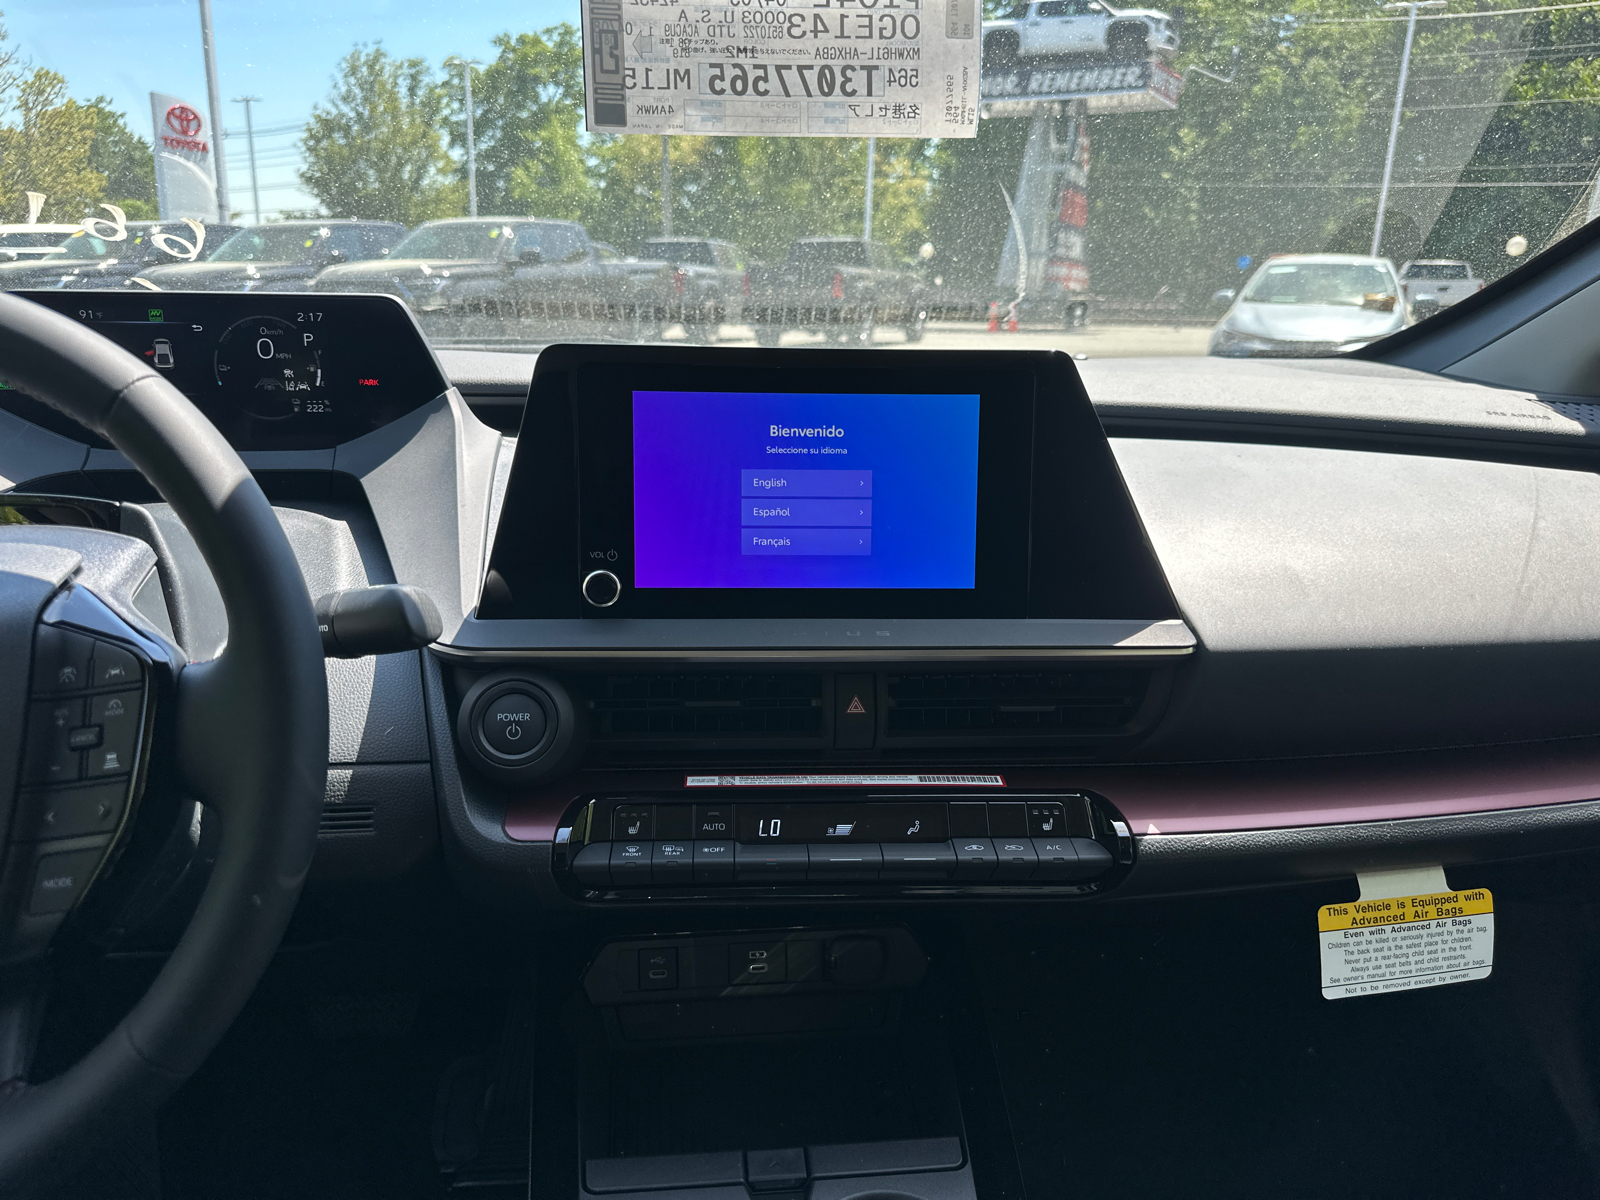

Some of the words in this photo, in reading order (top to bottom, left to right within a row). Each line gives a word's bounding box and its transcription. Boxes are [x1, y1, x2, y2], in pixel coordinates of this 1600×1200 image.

[162, 135, 209, 154] TOYOTA
[79, 309, 94, 319] 91
[297, 312, 323, 322] 2:17
[303, 333, 314, 347] P
[256, 338, 274, 359] 0
[359, 378, 380, 387] PARK
[306, 404, 324, 413] 222
[769, 424, 845, 438] Bienvenido
[766, 446, 808, 455] Seleccione
[820, 446, 848, 455] idioma
[753, 478, 787, 490] English
[753, 507, 791, 519] Español
[753, 536, 791, 549] Français
[589, 551, 605, 559] VOL
[497, 713, 531, 722] POWER
[703, 823, 726, 831] AUTO
[1326, 906, 1348, 917] This
[1354, 902, 1391, 914] Vehicle
[1397, 900, 1406, 909] is
[1411, 894, 1459, 909] Equipped
[1464, 891, 1485, 902] with
[1351, 912, 1406, 926] Advanced
[1413, 909, 1429, 919] Air
[1436, 906, 1464, 917] Bags
[1344, 930, 1364, 939] Even
[1369, 927, 1386, 936] with
[1390, 922, 1431, 934] Advanced
[1435, 920, 1447, 929] Air
[1452, 918, 1472, 927] Bags
[1328, 941, 1350, 949] Children
[1375, 936, 1390, 944] killed
[1400, 933, 1424, 941] seriously
[1426, 930, 1444, 938] injured
[1477, 926, 1488, 934] bag.
[1357, 947, 1370, 955] back
[1424, 940, 1439, 948] place
[1451, 936, 1473, 944] children.
[1363, 956, 1372, 964] put
[1381, 952, 1410, 961] rear-facing
[1385, 961, 1397, 969] seat
[1442, 953, 1467, 962] restraints.
[1343, 974, 1364, 982] owner's
[1367, 971, 1387, 979] manual
[1415, 964, 1443, 973] information
[1472, 959, 1486, 967] bags.
[1383, 980, 1411, 990] removed
[1414, 977, 1436, 985] except
[1439, 975, 1447, 983] by
[1450, 972, 1471, 980] owner.
